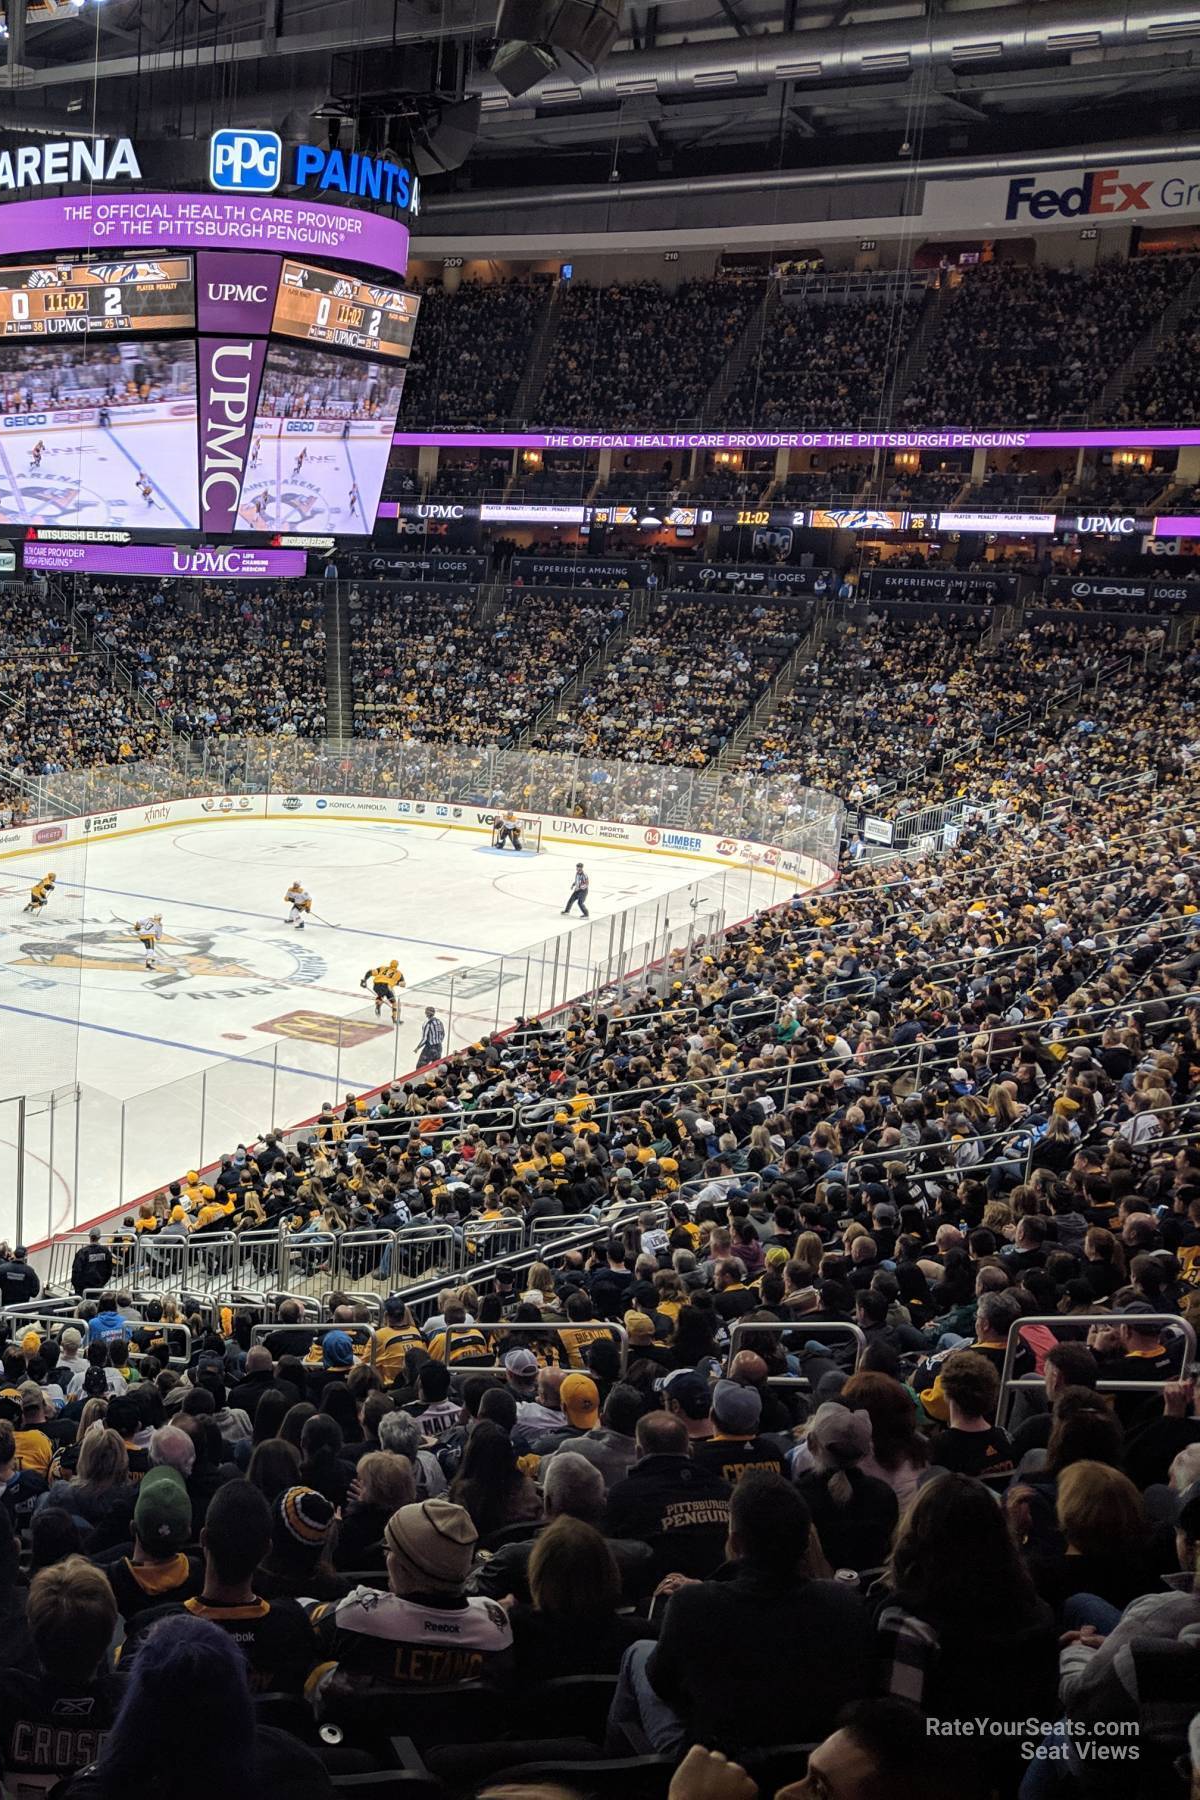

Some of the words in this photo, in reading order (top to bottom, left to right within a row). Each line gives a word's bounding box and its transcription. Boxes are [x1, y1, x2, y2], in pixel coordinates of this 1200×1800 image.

[216, 137, 276, 184] PPG
[296, 144, 409, 208] PAINTS
[1005, 170, 1153, 221] FedEx
[64, 206, 92, 220] THE
[97, 204, 173, 220] OFFICIAL
[178, 204, 245, 220] HEALTH
[250, 207, 293, 222] CARE
[298, 211, 362, 234] PROVIDER
[94, 221, 116, 235] OF
[121, 220, 154, 234] THE
[160, 220, 263, 237] PITTSBURGH
[1081, 229, 1097, 239] 212
[861, 241, 876, 250] 211
[443, 257, 463, 267] 209
[664, 252, 679, 261] 210
[207, 283, 268, 303] UPMC
[12, 293, 30, 320] 0
[47, 294, 85, 312] 11:02
[104, 287, 122, 316] 2
[47, 317, 87, 333] UPMC
[5, 415, 47, 427] GEICO
[201, 342, 252, 511] UPMC
[544, 435, 567, 447] THE
[572, 435, 630, 447] OFFICIAL
[634, 435, 684, 447] HEALTH
[689, 435, 724, 447] CARE
[729, 435, 796, 447] PROVIDER
[799, 435, 820, 447] OF
[825, 435, 851, 447] THE
[859, 435, 949, 447] PITTSBURGH
[417, 504, 464, 519] UPMC
[737, 511, 769, 525] 11:02
[793, 511, 804, 525] 2
[397, 518, 449, 535] FedEx
[911, 519, 925, 528] 25
[1077, 516, 1135, 533] UPMC
[37, 529, 85, 541] MITSUBISHI
[86, 531, 130, 543] ELECTRIC
[172, 551, 241, 573] UPMC
[438, 561, 467, 571] LOGES
[533, 564, 586, 574] EXPERIENCE
[589, 566, 628, 576] AMAZING
[773, 572, 804, 583] LOGES
[885, 576, 944, 588] EXPERIENCE
[1093, 586, 1145, 596] LEXUS
[1154, 588, 1187, 599] LOGES
[329, 802, 357, 810] KONICA
[359, 803, 387, 811] MINOLTA
[93, 816, 117, 825] RAM
[144, 806, 170, 823] xfinity
[93, 823, 117, 832] 1500
[552, 820, 594, 836] UPMC
[600, 826, 625, 834] SPORTS
[600, 832, 630, 841] MEDICINE
[662, 834, 701, 849] LUMBER
[424, 1620, 460, 1634] Reebok
